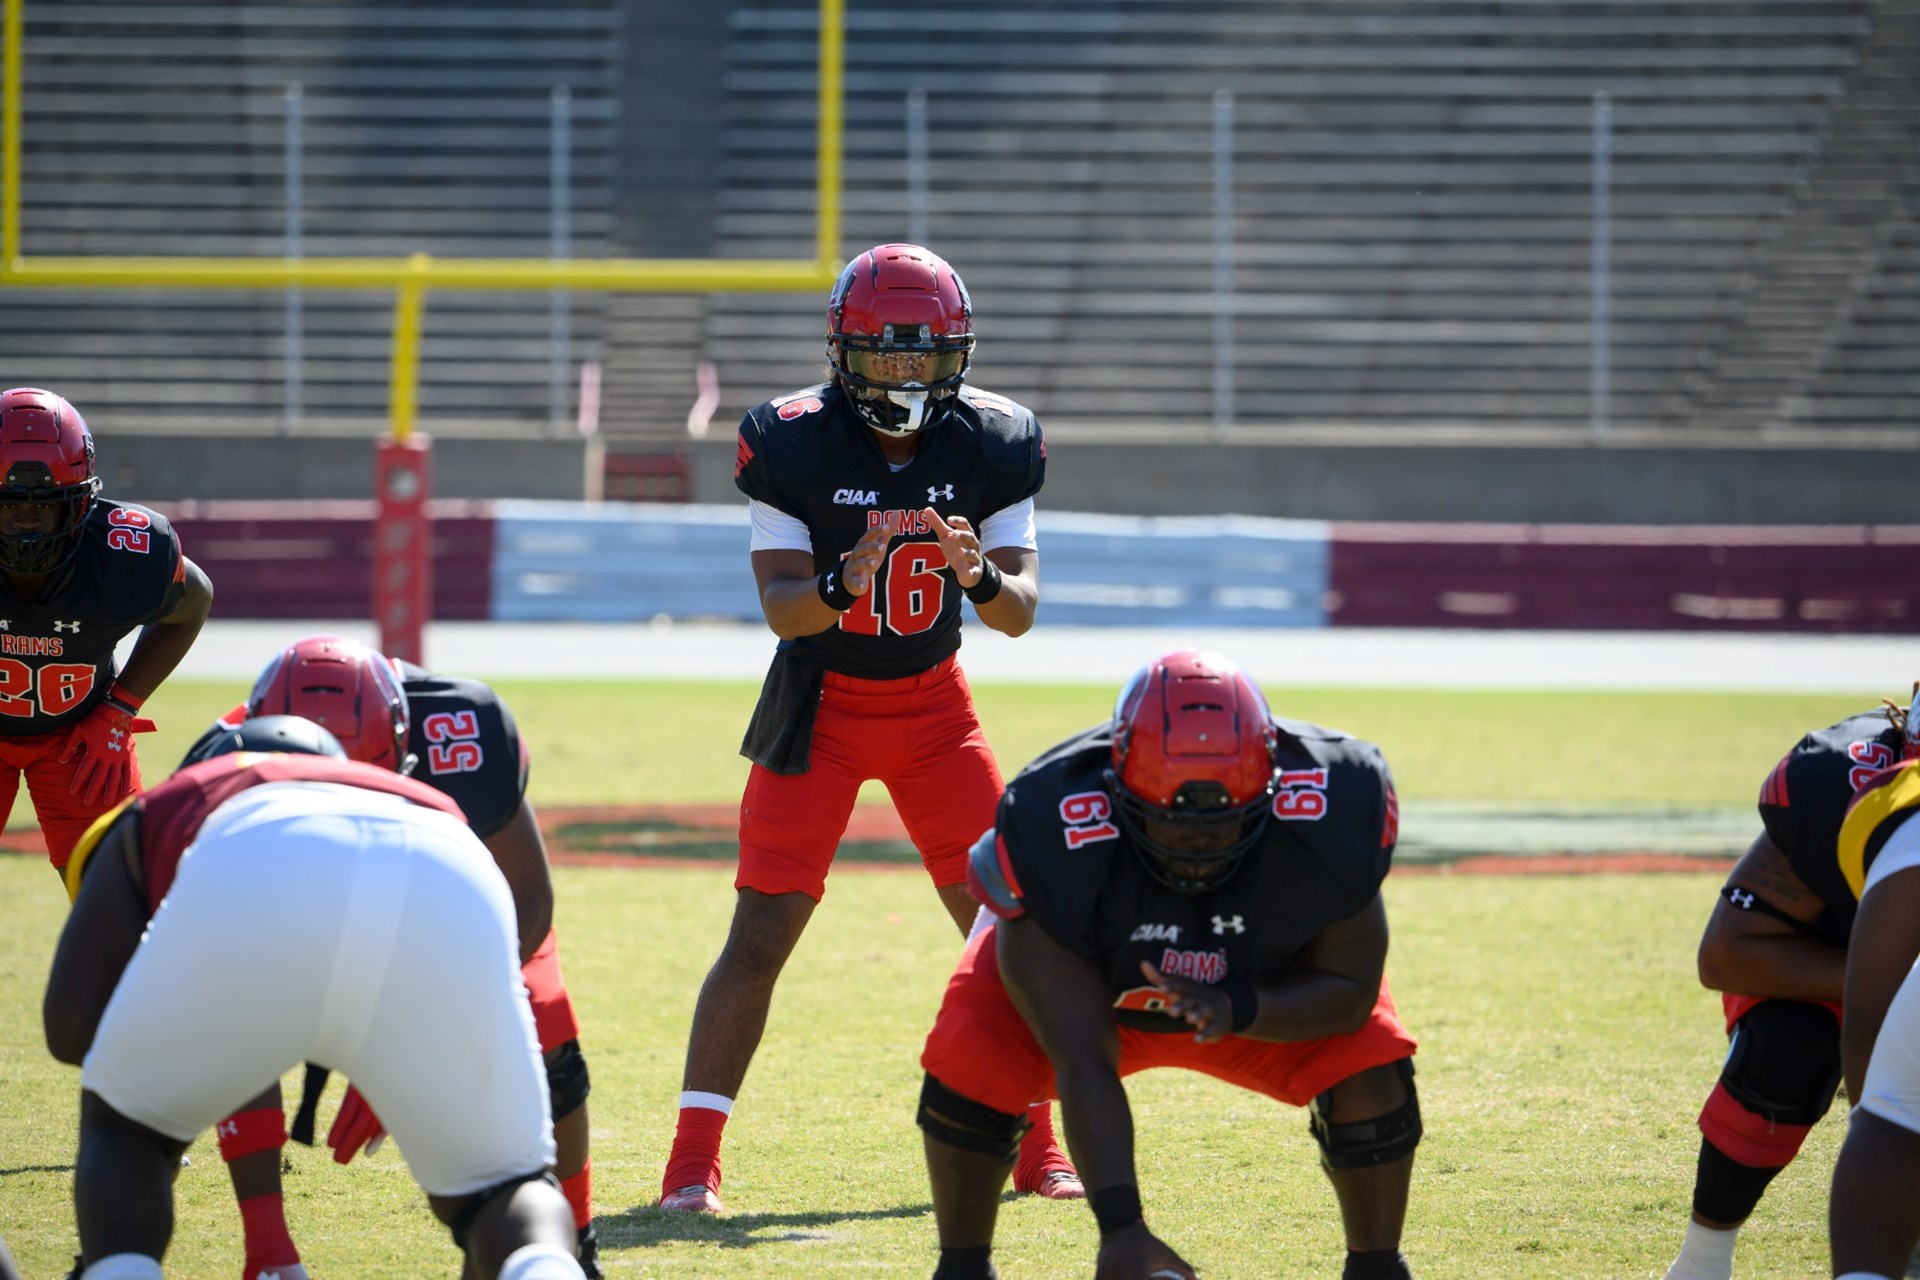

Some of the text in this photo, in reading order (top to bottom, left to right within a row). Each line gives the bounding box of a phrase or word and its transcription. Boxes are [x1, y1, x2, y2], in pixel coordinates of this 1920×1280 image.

[832, 488, 880, 506] CIAA
[107, 507, 150, 554] 26
[838, 541, 950, 637] 16
[1, 634, 64, 656] RAMS
[0, 657, 97, 718] 26
[423, 710, 484, 776] 52
[1058, 790, 1121, 850] 61
[1271, 767, 1329, 821] 61
